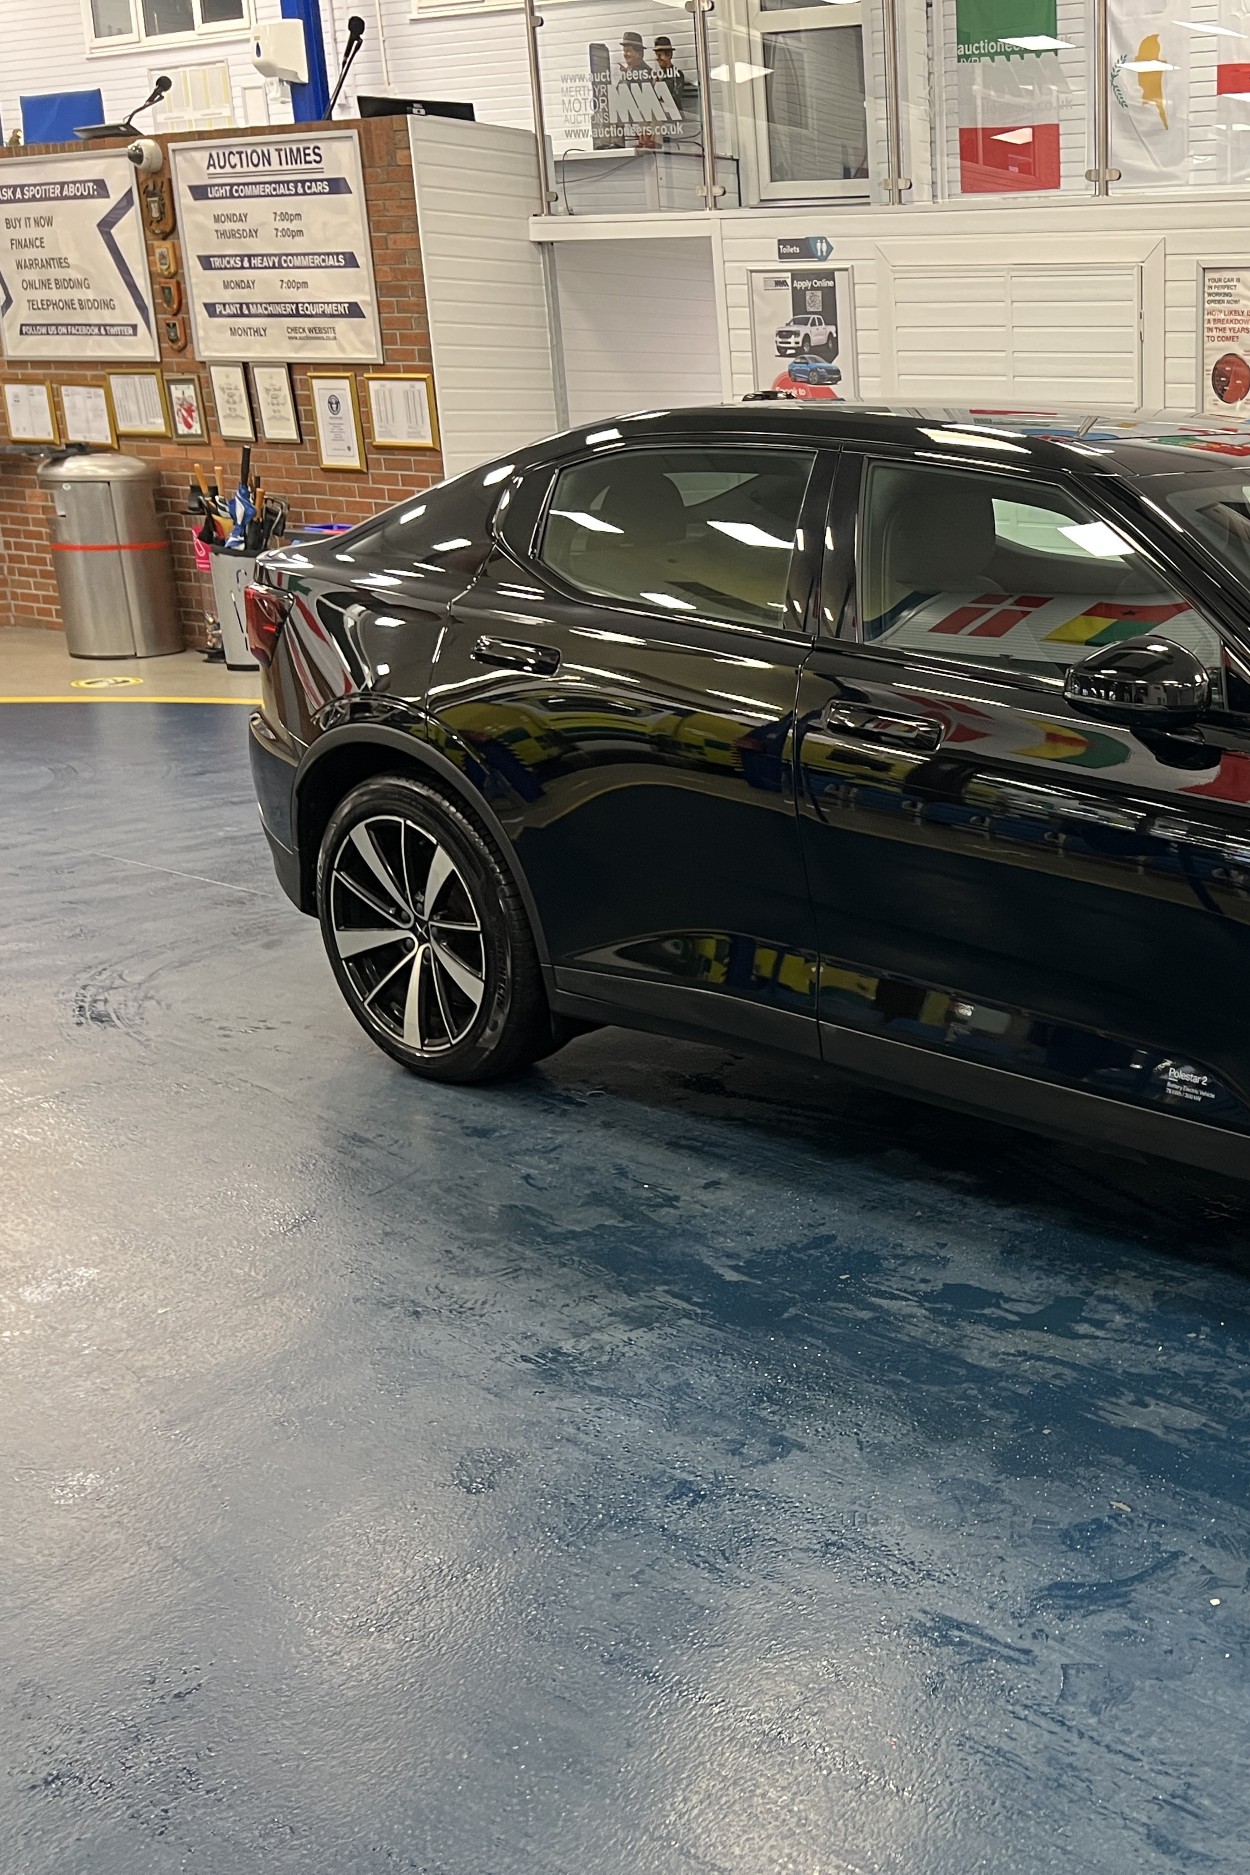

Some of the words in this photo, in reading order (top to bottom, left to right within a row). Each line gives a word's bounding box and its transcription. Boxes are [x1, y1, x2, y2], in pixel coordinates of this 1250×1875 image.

[561, 84, 607, 97] MERTHYR
[562, 97, 608, 113] MOTOR
[607, 81, 682, 123] MMA
[564, 113, 609, 124] AUCTIONS
[565, 122, 683, 138] www.auctioneers.co.uk
[206, 149, 272, 170] AUCTION
[275, 145, 322, 165] TIMES
[16, 187, 22, 198] A
[24, 184, 60, 198] SPOTTER
[63, 182, 97, 197] ABOUT:
[208, 185, 230, 197] LIGHT
[233, 183, 295, 197] COMMERCIALS
[297, 183, 303, 194] &
[305, 181, 329, 193] CARS
[5, 217, 23, 229] BUY
[25, 217, 32, 228] IT
[34, 216, 53, 227] NOW
[214, 213, 248, 223] MONDAY
[273, 212, 302, 224] 7:00pm
[215, 228, 258, 239] THURSDAY
[274, 228, 304, 240] 7:00pm
[10, 237, 45, 250] FINANCE
[779, 245, 800, 253] Toilets
[16, 257, 70, 270] WARRANTIES
[210, 256, 241, 268] TRUCKS
[243, 256, 249, 267] &
[251, 256, 279, 268] HEAVY
[281, 255, 345, 267] COMMERCIALS
[22, 278, 53, 291] ONLINE
[55, 278, 90, 289] BIDDING
[223, 279, 256, 290] MONDAY
[280, 279, 308, 290] 7:00pm
[793, 280, 812, 290] Apply
[813, 278, 834, 287] Online
[27, 299, 77, 311] TELEPHONE
[78, 299, 116, 310] BIDDING
[216, 304, 240, 314] PLANT
[242, 304, 248, 314] &
[250, 304, 297, 314] MACHINERY
[299, 303, 349, 314] EQUIPMENT
[22, 326, 47, 335] FOLLOW
[48, 326, 57, 335] US
[58, 326, 67, 335] ON
[230, 327, 267, 337] MONTHLY
[307, 326, 336, 334] WEBSITE
[1169, 1068, 1200, 1083] Polestar
[1201, 1076, 1208, 1085] 2
